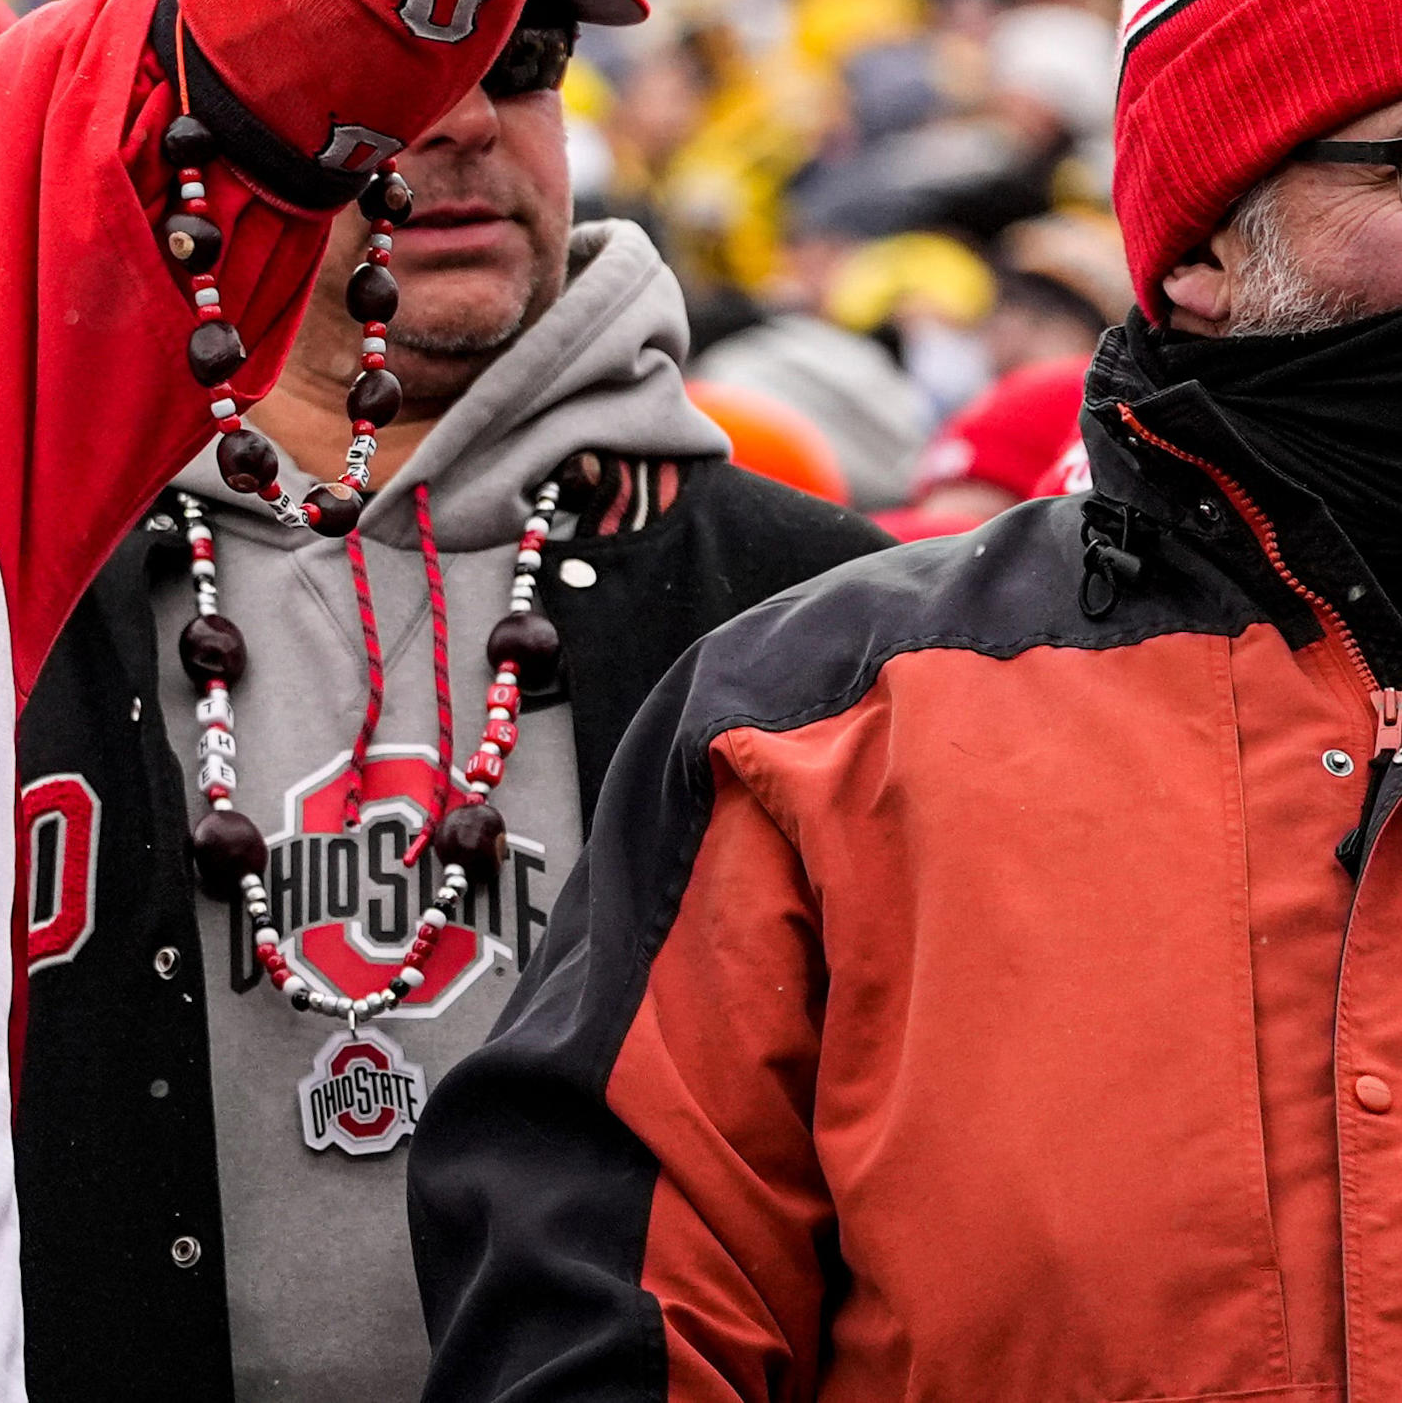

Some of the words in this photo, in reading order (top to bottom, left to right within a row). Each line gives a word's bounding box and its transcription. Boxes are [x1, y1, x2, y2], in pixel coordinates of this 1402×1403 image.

[201, 701, 233, 784] THE
[486, 687, 512, 777] OSU
[310, 1075, 355, 1139] OHIO
[353, 1066, 418, 1125] STATE
